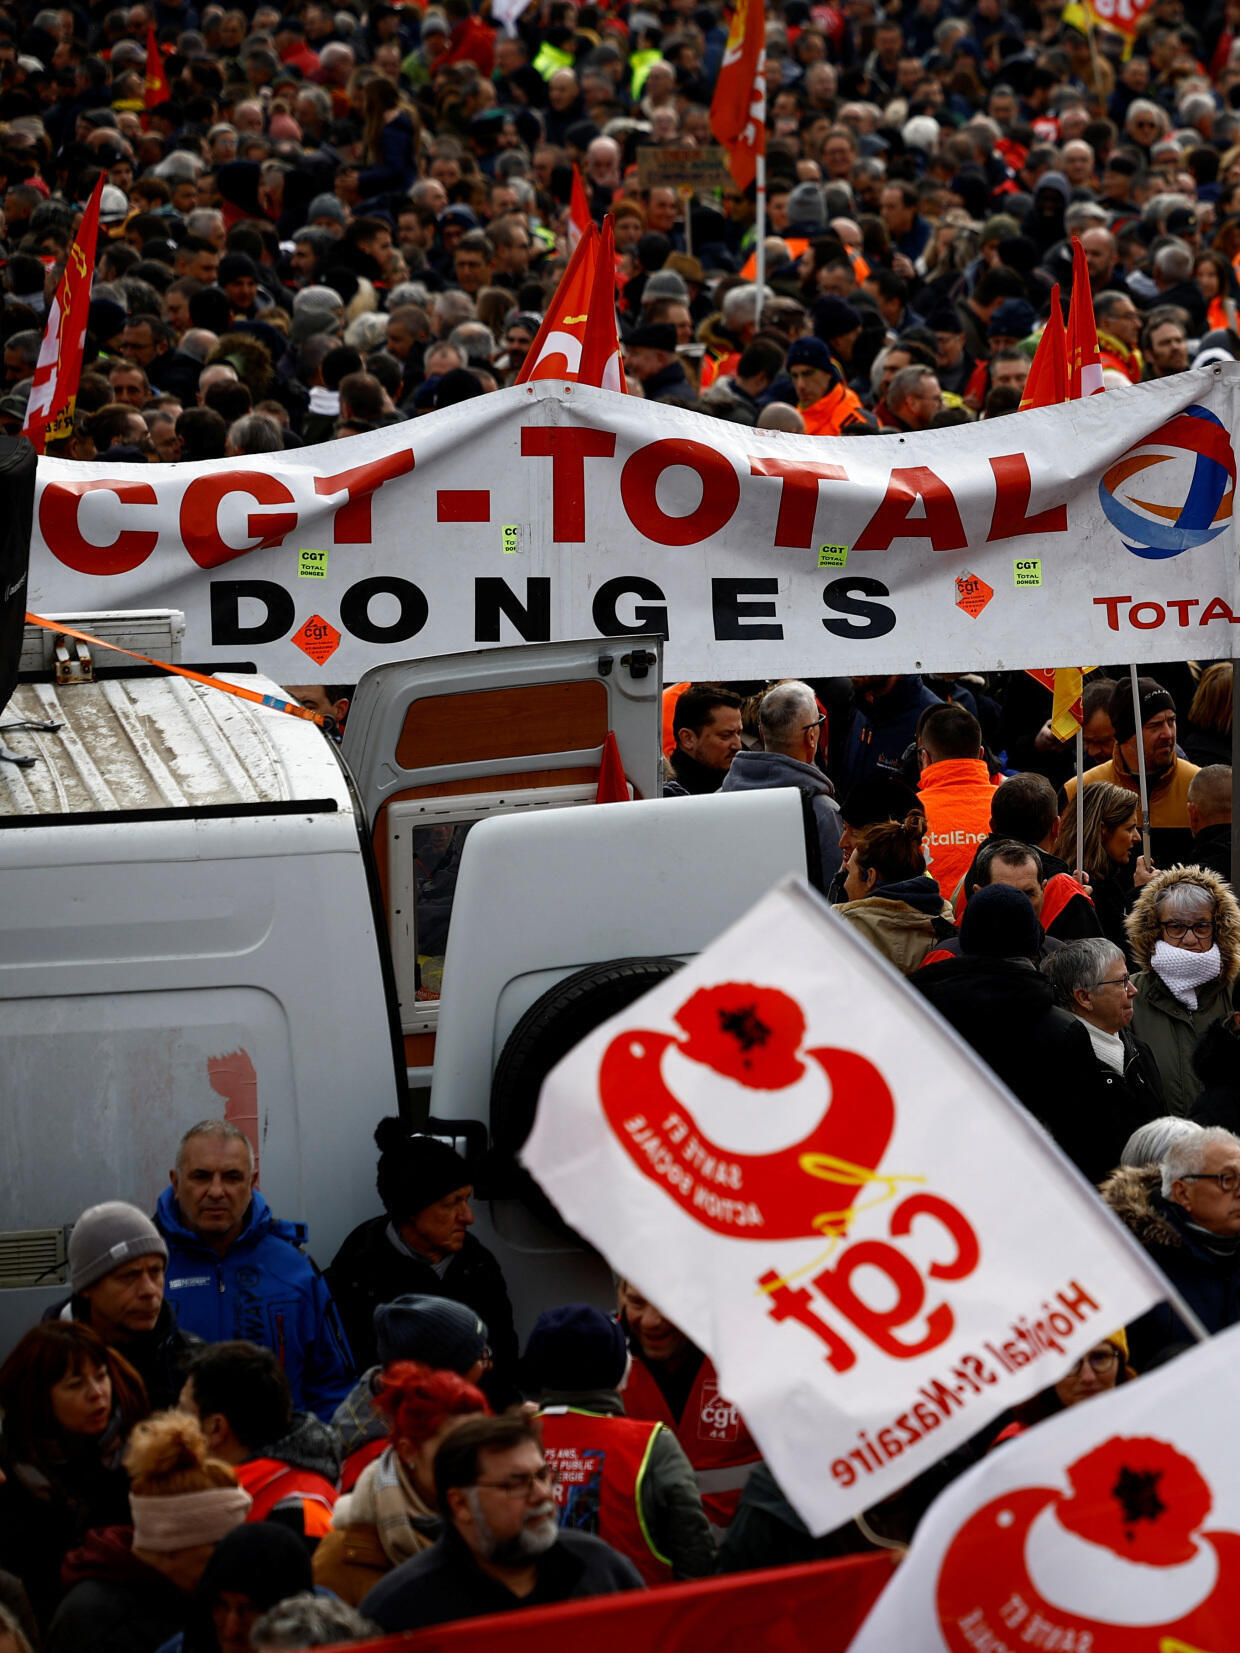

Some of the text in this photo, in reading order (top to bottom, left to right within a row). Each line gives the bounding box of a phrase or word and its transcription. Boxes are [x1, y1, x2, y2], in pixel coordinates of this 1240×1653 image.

[822, 546, 845, 554] CGT
[301, 552, 325, 561] CGT
[301, 563, 325, 571] TOTAL
[1016, 561, 1038, 570] CGT
[957, 580, 980, 595] cgt
[210, 575, 897, 646] DONGES
[304, 625, 328, 640] cgt
[701, 1406, 738, 1430] cgt
[559, 1459, 596, 1471] PUBLIC
